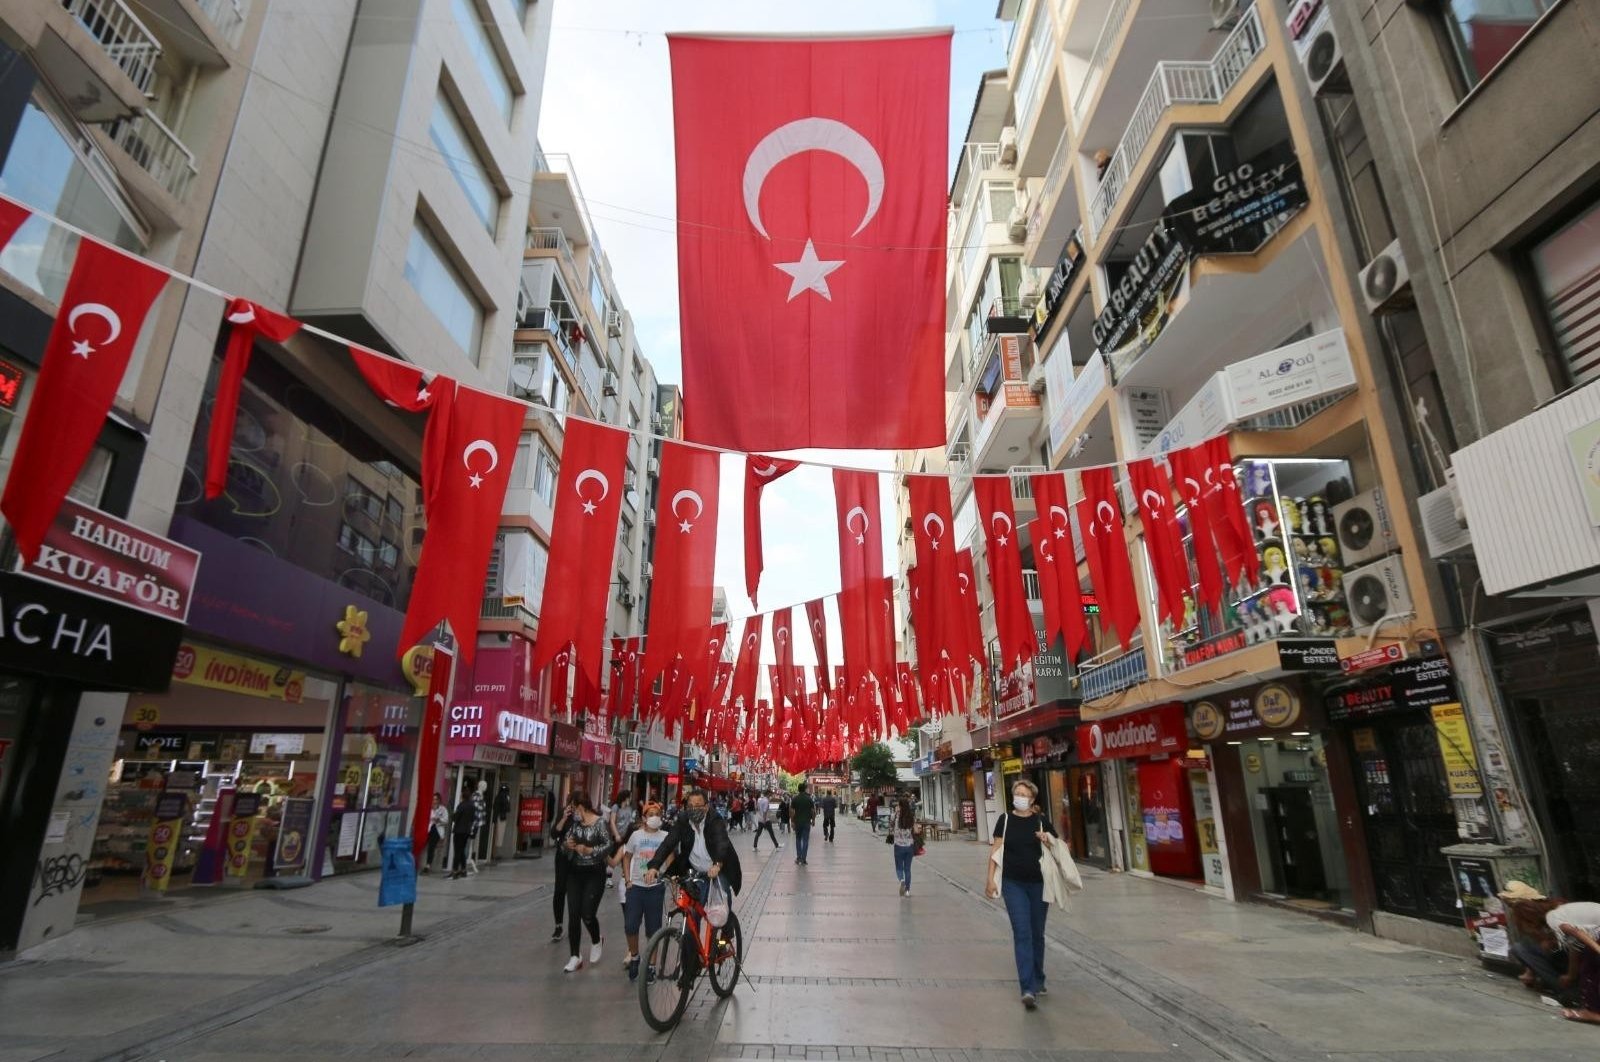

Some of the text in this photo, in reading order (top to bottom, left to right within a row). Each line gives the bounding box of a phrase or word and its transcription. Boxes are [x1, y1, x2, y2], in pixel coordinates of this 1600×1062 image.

[1192, 163, 1286, 223] BEAUTY
[1213, 163, 1253, 193] GIO
[1111, 215, 1170, 314] BEAUTY
[1091, 305, 1118, 346] GIO
[71, 515, 173, 571] HAIRIUM
[34, 545, 181, 612] KUAFÖR
[204, 657, 270, 692] İNDİRİM
[1035, 667, 1063, 677] KARYA
[139, 737, 182, 748] NOTE
[450, 724, 481, 738] PITI
[1104, 722, 1157, 748] vodafone
